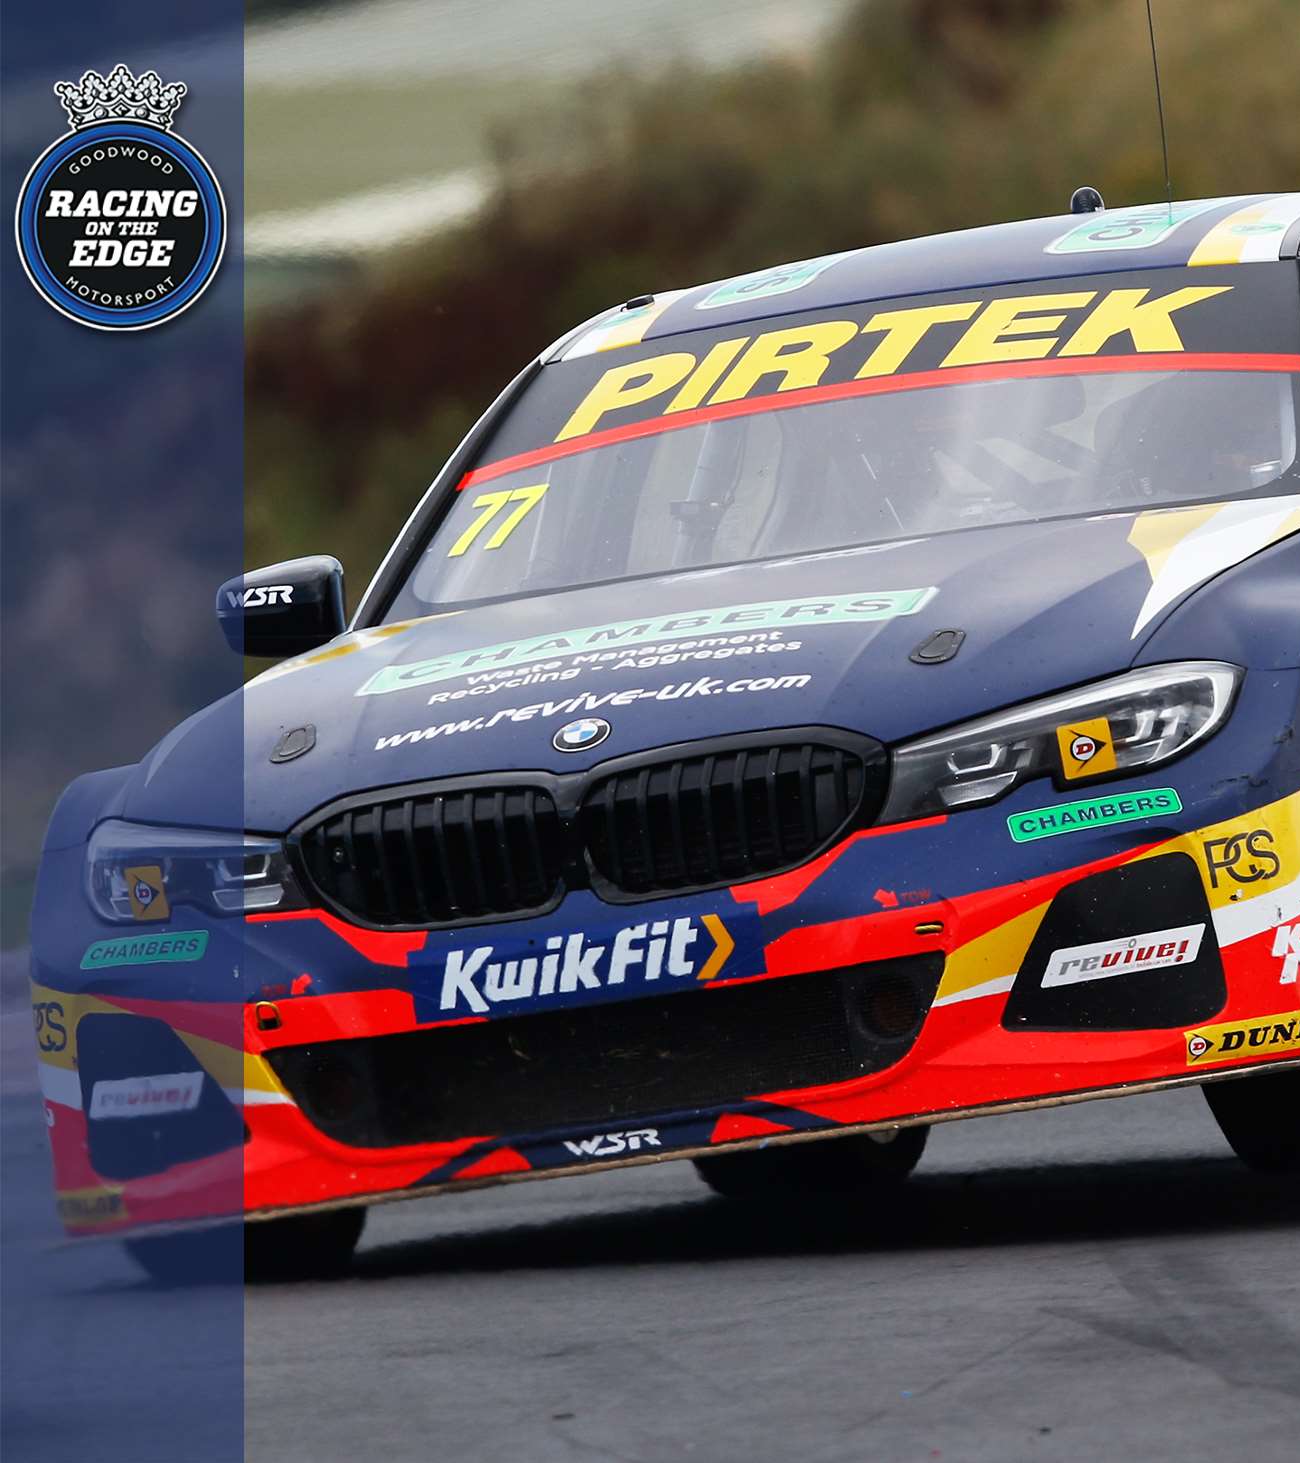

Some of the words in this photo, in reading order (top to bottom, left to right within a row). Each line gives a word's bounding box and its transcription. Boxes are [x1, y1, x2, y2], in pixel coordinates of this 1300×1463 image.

[554, 286, 1234, 444] PIRTEK
[447, 483, 551, 558] 77
[226, 585, 294, 608] WSR
[399, 598, 894, 680] CHAMBERS
[466, 660, 562, 685] Waste
[572, 630, 783, 665] Management
[428, 667, 580, 705] Recycling
[612, 639, 802, 671] Aggregates
[374, 673, 812, 750] www.revive-uk.com
[1019, 795, 1172, 834] CHAMBERS
[1202, 829, 1280, 889] PCS
[90, 938, 200, 961] CHAMBERS
[563, 1127, 662, 1157] WSR
